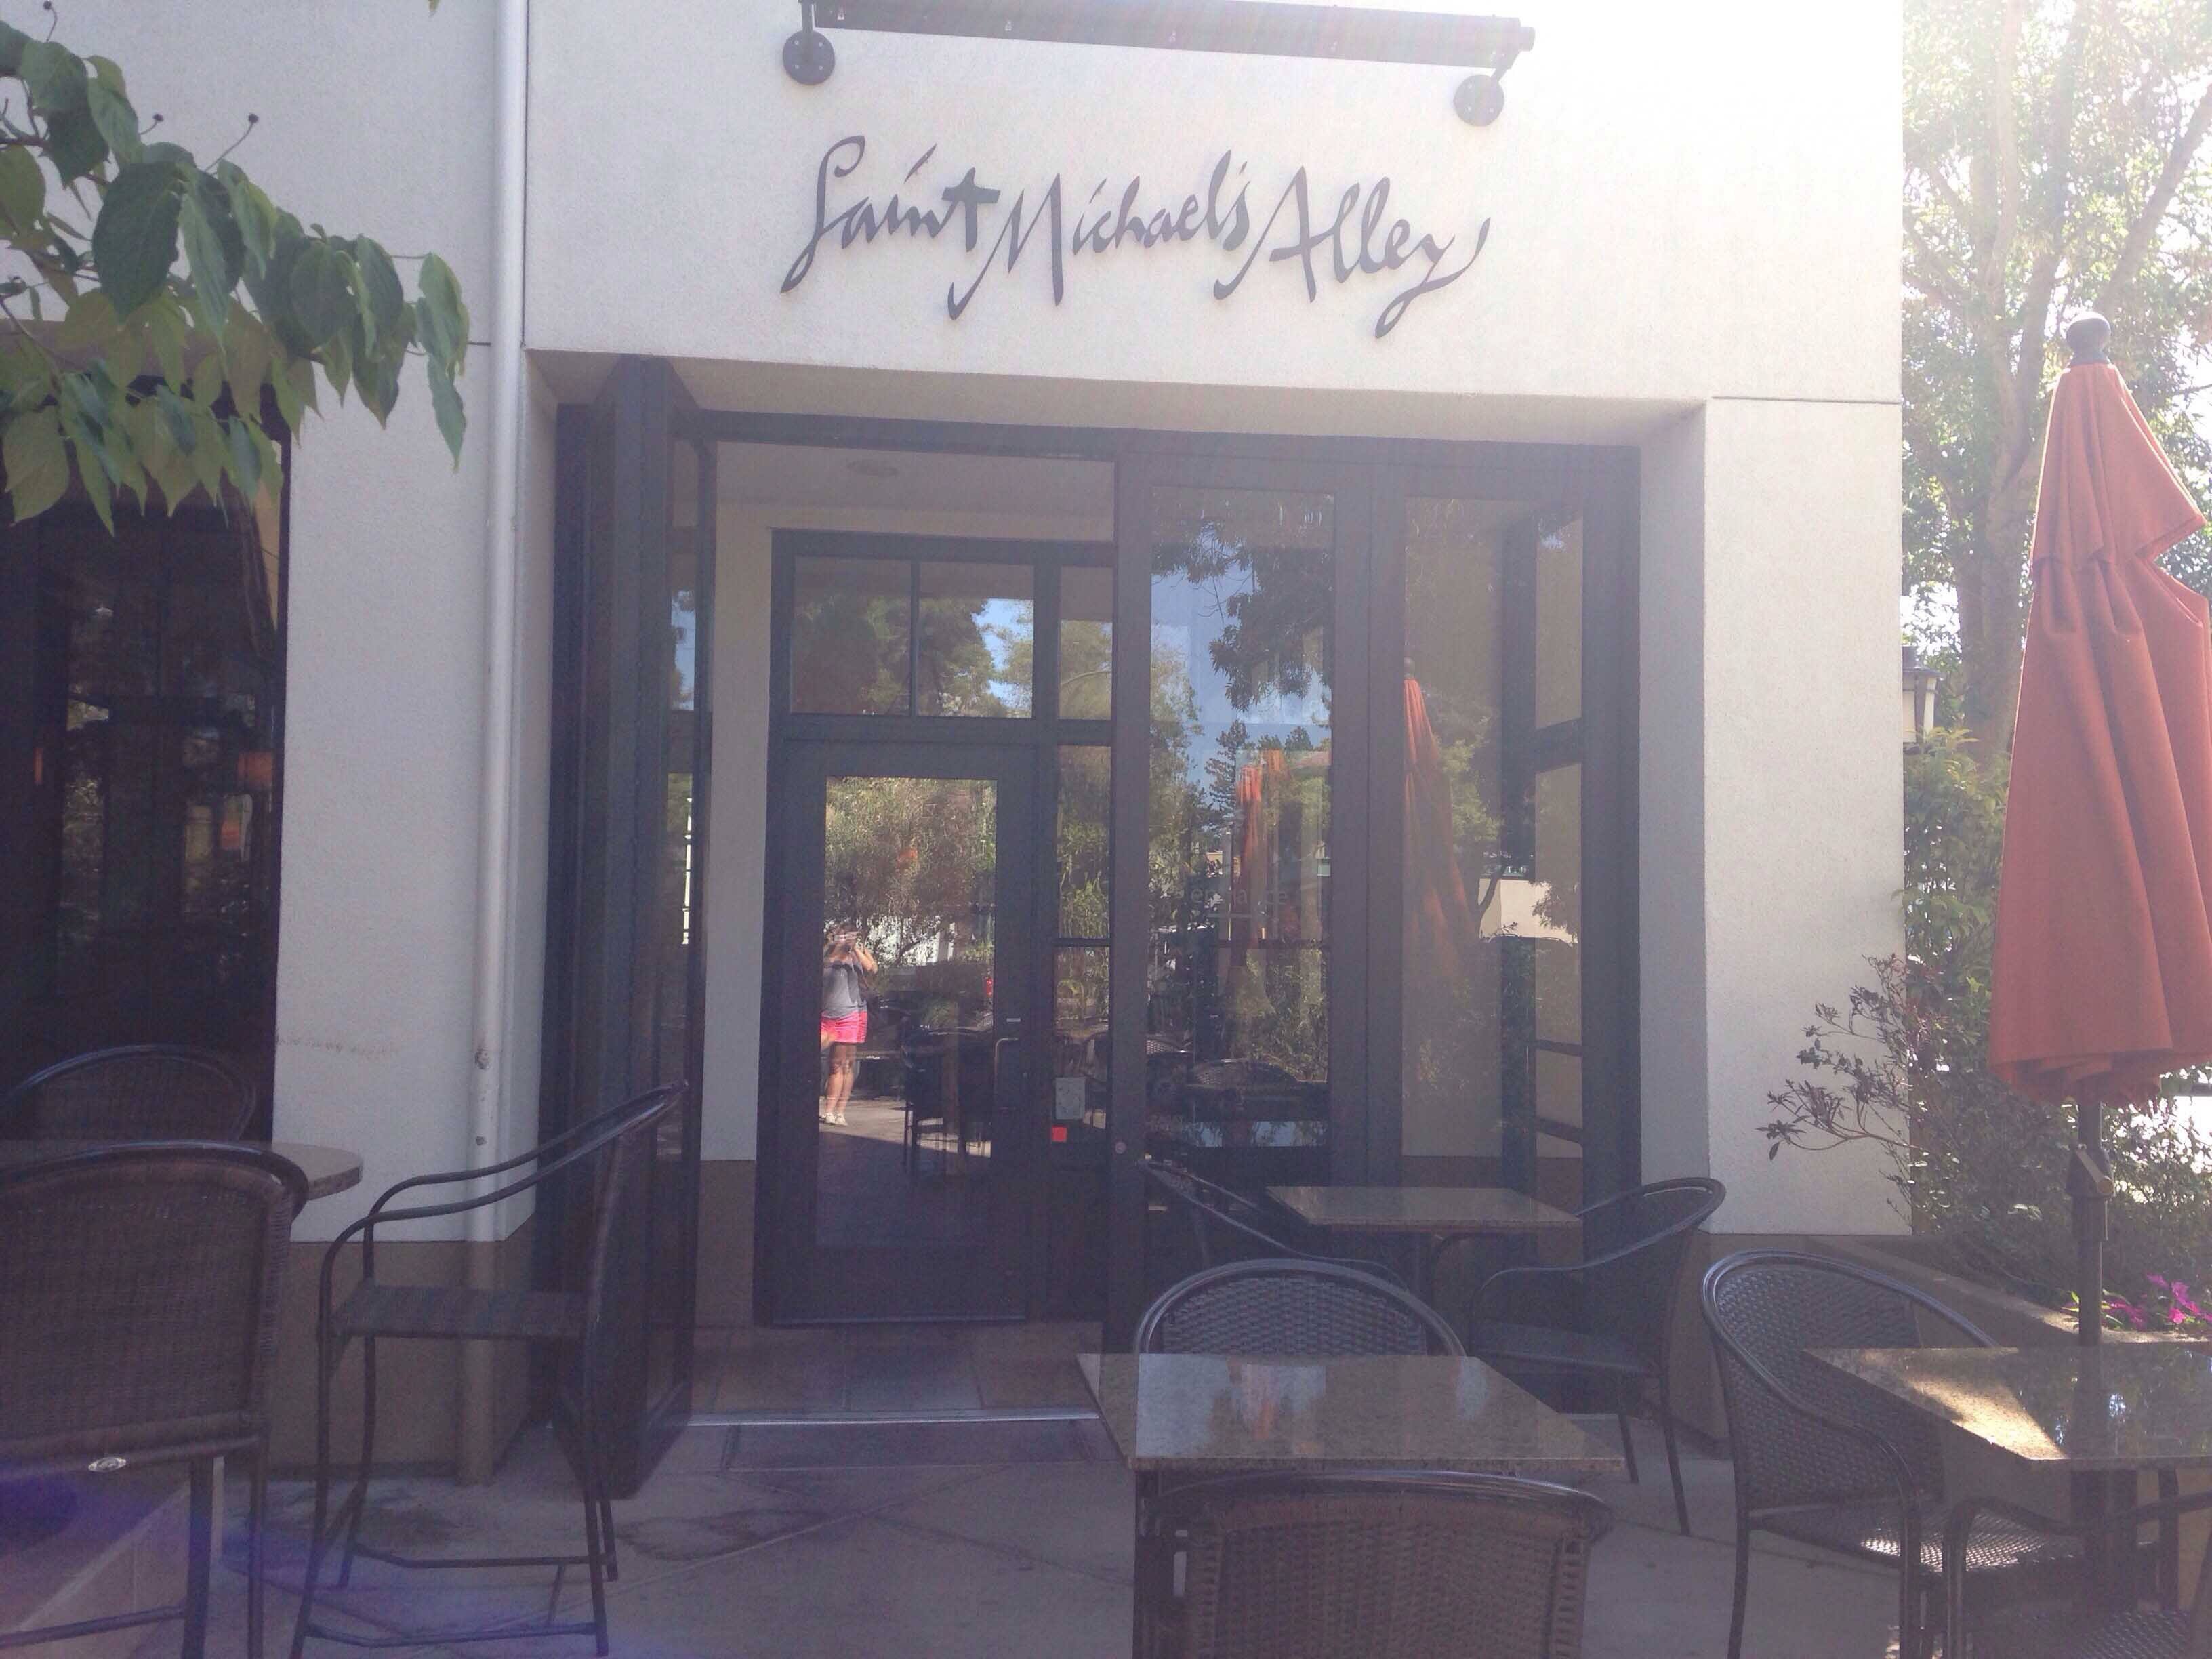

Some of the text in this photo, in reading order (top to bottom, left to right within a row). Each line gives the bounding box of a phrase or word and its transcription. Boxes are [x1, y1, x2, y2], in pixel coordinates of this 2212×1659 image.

[780, 135, 1490, 339] Saint Michael's Alley
